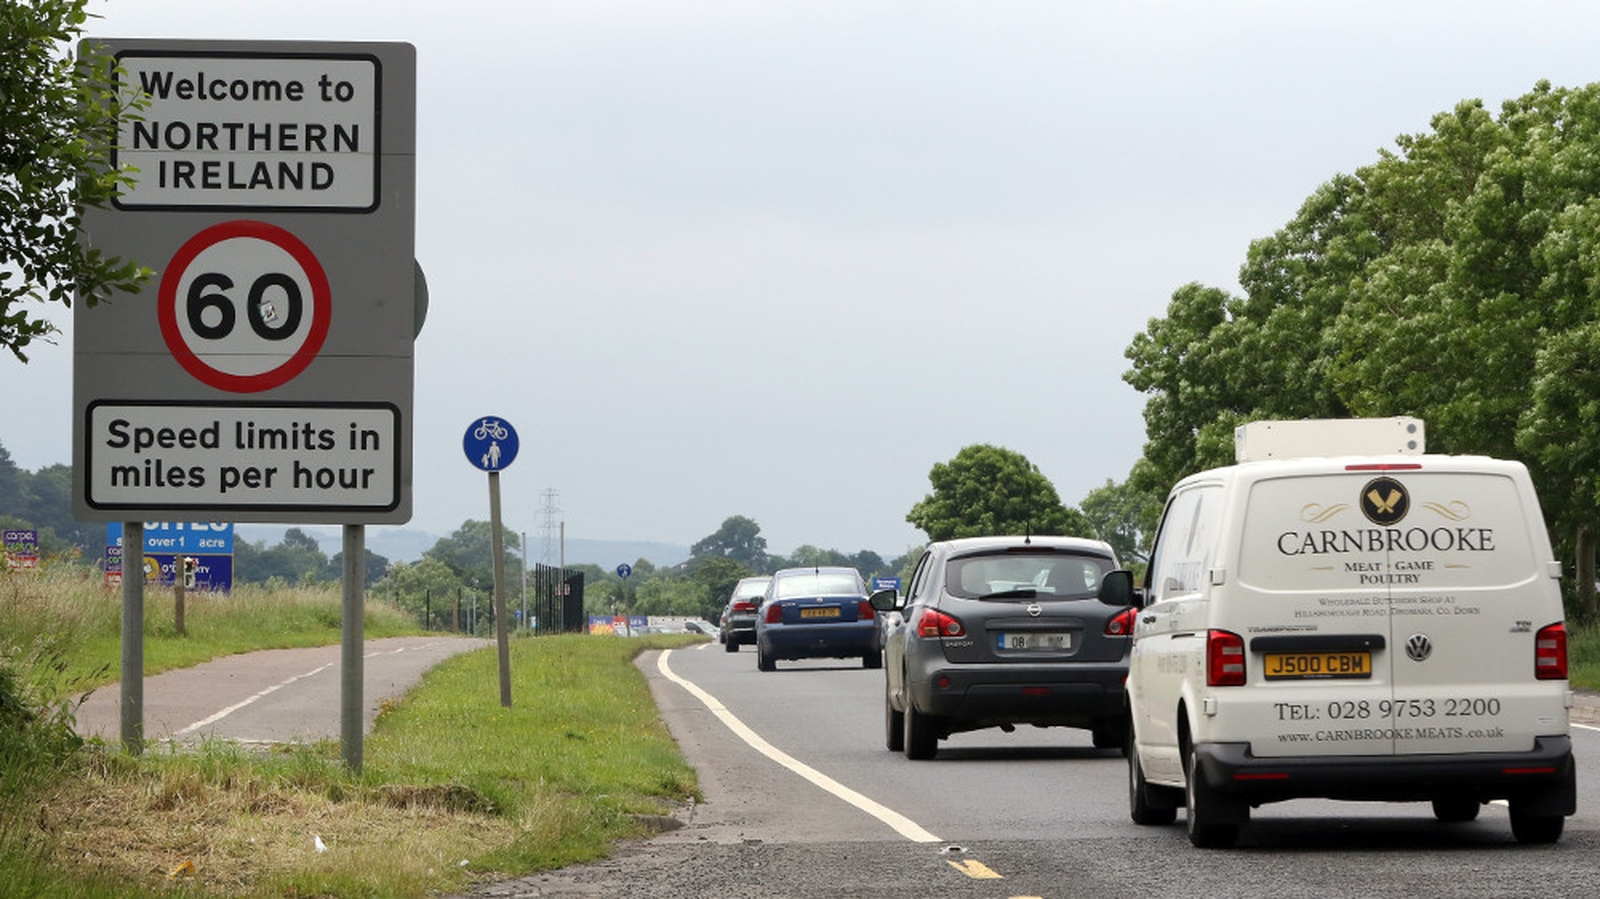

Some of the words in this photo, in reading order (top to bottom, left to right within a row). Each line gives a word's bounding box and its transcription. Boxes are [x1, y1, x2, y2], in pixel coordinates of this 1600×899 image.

[139, 71, 304, 101] Welcome
[318, 74, 355, 102] to
[133, 121, 359, 152] NORTHERN
[159, 161, 335, 190] IRELAND
[186, 272, 303, 341] 60
[106, 419, 220, 453] Speed
[235, 421, 336, 451] limits
[350, 422, 380, 451] in
[111, 459, 206, 487] miles
[220, 465, 277, 493] per
[293, 460, 375, 489] hour
[148, 538, 176, 547] over
[179, 536, 185, 546] 1
[199, 538, 225, 548] acre
[1277, 527, 1495, 556] CARNBROOKE
[1345, 562, 1382, 572] MEAT
[1394, 561, 1435, 571] GAME
[1360, 574, 1421, 585] POULTRY
[1012, 636, 1025, 649] 08
[1272, 655, 1320, 673] J500
[1326, 655, 1363, 673] CBM
[1273, 703, 1320, 720] TEL:
[1327, 700, 1371, 719] 028
[1378, 699, 1436, 718] 9753
[1444, 698, 1501, 717] 2200
